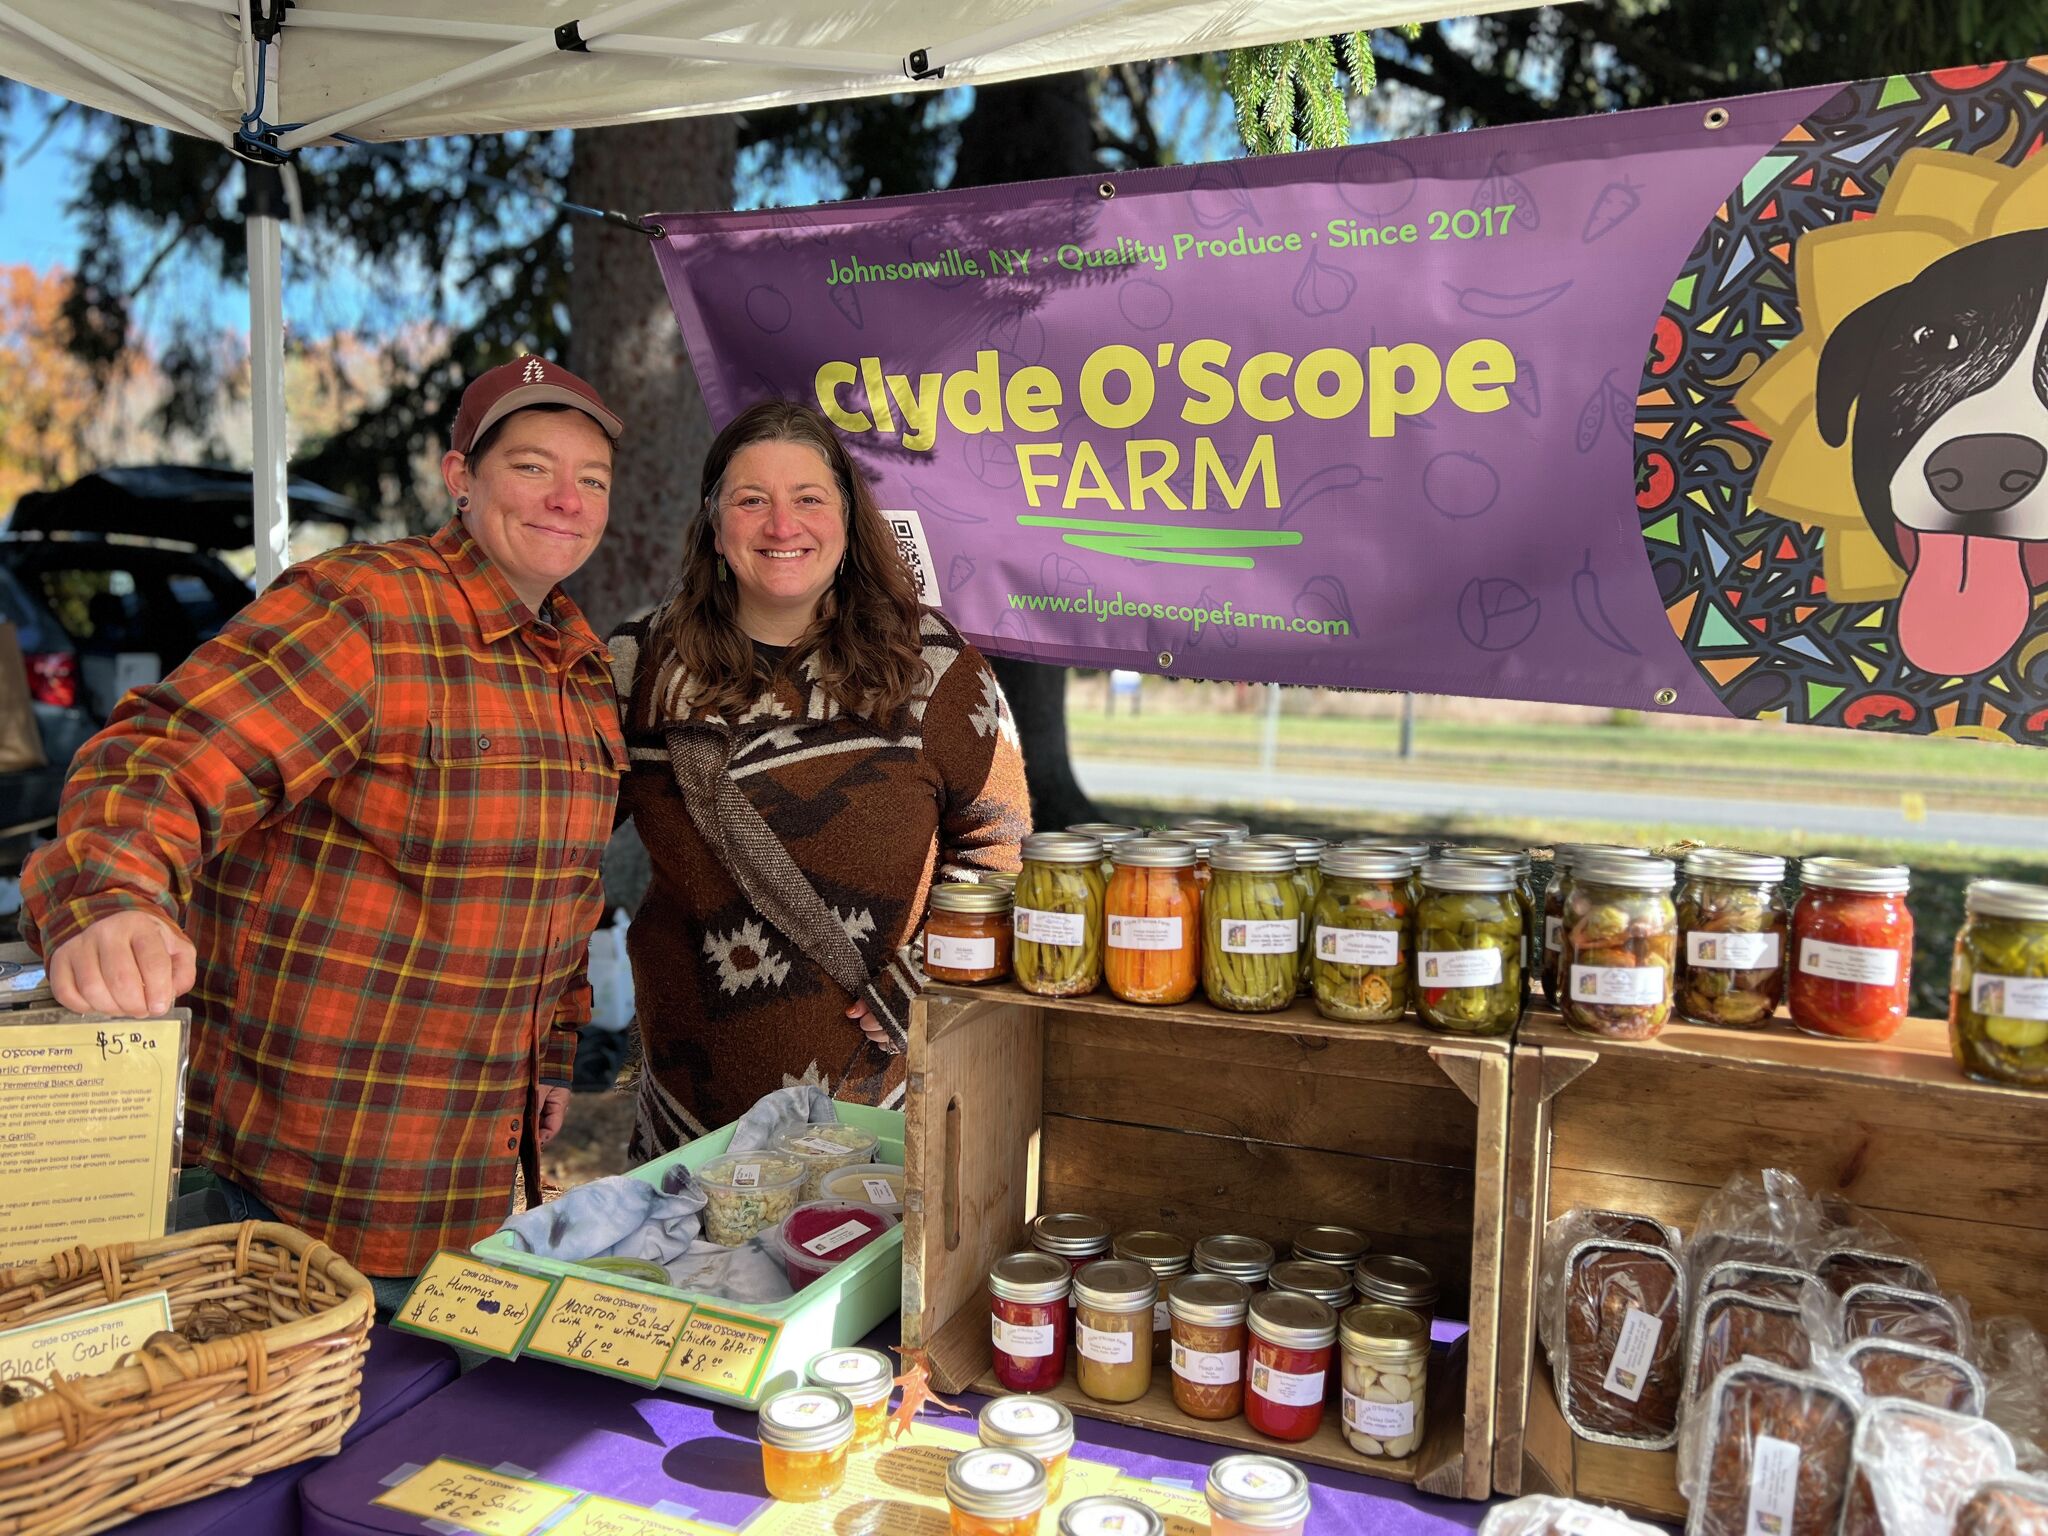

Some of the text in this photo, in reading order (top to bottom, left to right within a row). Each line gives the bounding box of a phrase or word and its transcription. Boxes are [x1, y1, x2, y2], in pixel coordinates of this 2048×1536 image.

[827, 204, 1517, 287] Johnsonville, NY Quality Produce Since 2017
[1079, 338, 1517, 438] O'Scope
[1014, 434, 1281, 511] FARM
[1007, 589, 1350, 638] www.clydeoscopefarm.com
[48, 1047, 73, 1057] Farm
[446, 1276, 494, 1299] Hummus
[557, 1298, 675, 1333] Macaroni Salad
[0, 1334, 131, 1381] Black Garlic
[680, 1330, 716, 1347] Chicken
[482, 1494, 533, 1514] Salad
